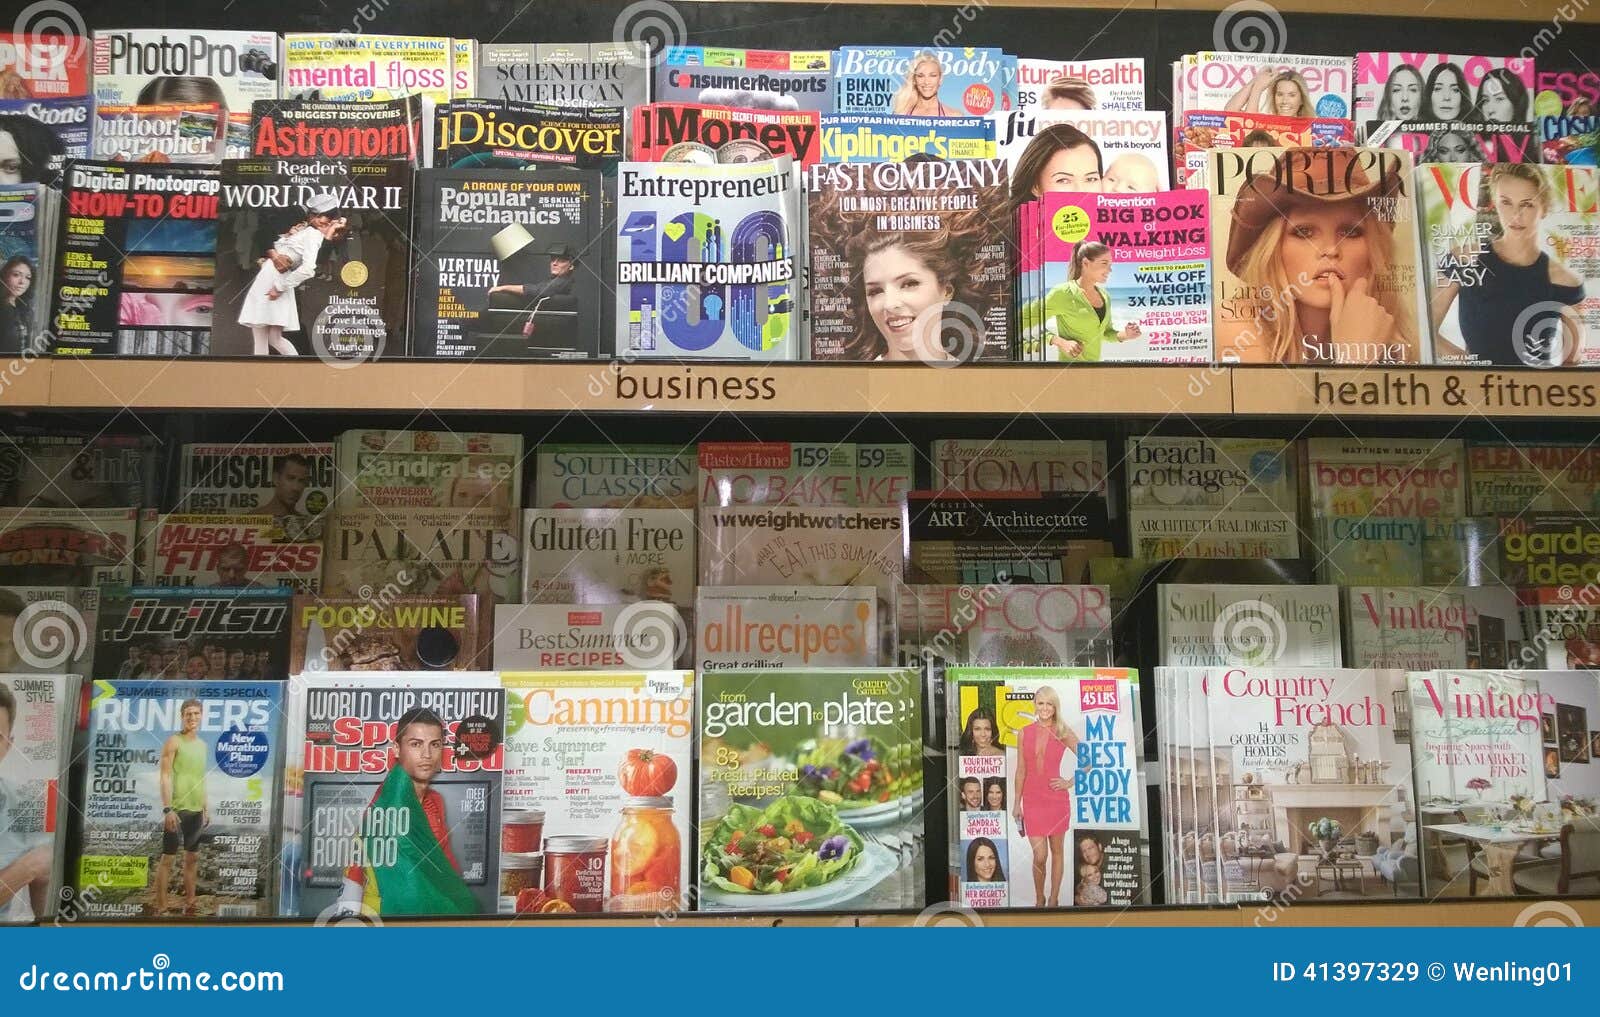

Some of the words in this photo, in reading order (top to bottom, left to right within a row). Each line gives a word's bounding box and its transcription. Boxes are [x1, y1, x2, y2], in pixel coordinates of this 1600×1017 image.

[289, 41, 315, 49] HOW
[359, 41, 371, 49] AT
[375, 40, 445, 49] EVERYTHING
[111, 33, 236, 76] PhotoPro
[289, 61, 445, 87] mental_floss
[497, 62, 625, 81] SCIENTIFIC
[500, 83, 624, 101] AMERICAN
[669, 70, 826, 96] ConsumerReports
[847, 94, 893, 107] READY
[295, 111, 338, 119] BIGGEST
[340, 110, 400, 119] DISCOVERIES
[451, 112, 620, 154] Discover
[656, 109, 816, 162] Money
[1000, 111, 1037, 146] fit
[1451, 123, 1483, 131] MUSIC
[1486, 124, 1531, 133] SPECIAL
[255, 117, 419, 160] Astronomy
[821, 127, 947, 162] Kiplinger's
[1131, 141, 1161, 149] beyond
[277, 161, 347, 176] Reader's
[811, 163, 871, 192] FAST
[873, 159, 1004, 192] COMPANY
[72, 173, 129, 191] Digital
[134, 174, 220, 195] Photograp
[291, 176, 319, 185] digest
[472, 183, 507, 191] DRONE
[623, 171, 790, 205] Entrepreneur
[70, 191, 164, 217] HOW-TO
[322, 186, 379, 208] WAR
[440, 188, 531, 209] Popular
[840, 198, 856, 211] 100
[861, 197, 887, 211] MOST
[891, 196, 938, 211] CREATIVE
[941, 195, 977, 210] PEOPLE
[1097, 196, 1156, 207] Prevention
[440, 206, 560, 224] Mechanics
[877, 216, 886, 230] IN
[891, 216, 940, 230] BUSINESS
[1063, 213, 1078, 222] 25
[1097, 208, 1134, 223] BIG
[1142, 205, 1204, 222] BOOK
[1098, 228, 1205, 247] WALKING
[1432, 223, 1493, 237] SUMMER
[1115, 249, 1132, 259] For
[1136, 248, 1176, 258] Weight
[1179, 247, 1205, 257] Loss
[1432, 236, 1490, 255] STYLE
[439, 258, 500, 273] VIRTUAL
[620, 263, 702, 282] BRILLIANT
[706, 260, 792, 284] COMPANIES
[440, 273, 500, 288] REALITY
[1134, 273, 1172, 284] WALK
[1178, 271, 1206, 282] OFF
[1435, 268, 1486, 288] EASY
[1149, 283, 1206, 295] WEIGHT
[329, 296, 376, 305] Illustrated
[1128, 296, 1145, 307] 3X
[1150, 294, 1206, 306] FASTER!
[326, 306, 379, 315] Celebration
[1140, 317, 1207, 326] METABOLISM
[1149, 331, 1170, 345] 23
[1172, 330, 1202, 338] Simple
[1172, 338, 1207, 346] Recipes
[329, 342, 373, 352] American
[1302, 335, 1411, 361] Summer
[616, 367, 776, 400] business
[1314, 372, 1429, 406] health
[1442, 376, 1467, 406] &
[1481, 374, 1596, 407] fitness
[796, 448, 829, 468] 159
[1135, 439, 1215, 464] beach
[360, 456, 456, 478] Sandra
[463, 458, 511, 478] Lee
[553, 453, 692, 477] SOUTHERN
[1131, 466, 1247, 493] cottages
[1316, 462, 1457, 493] backyard
[563, 476, 681, 500] CLASSICS
[736, 511, 900, 531] weightwatchers
[928, 511, 966, 527] ART
[984, 510, 1088, 528] Architecture
[1138, 519, 1243, 533] ARCHITECTURAL
[1245, 520, 1288, 533] DIGEST
[160, 525, 258, 544] MUSCLE
[530, 517, 616, 551] Gluten
[628, 517, 683, 551] Free
[336, 529, 518, 561] PALATE
[164, 544, 320, 575] FITESS
[302, 607, 374, 628] FOOD
[395, 607, 466, 628] WINE
[541, 652, 624, 667] RECIPES
[703, 660, 737, 671] Great
[14, 679, 54, 692] SUMMER
[1224, 669, 1335, 702] Country
[27, 691, 55, 703] STYLE
[310, 692, 371, 720] WORLD
[380, 691, 414, 720] CUP
[421, 691, 498, 721] PREVIEW
[720, 691, 746, 703] from
[1082, 692, 1096, 705] 45
[1098, 692, 1116, 705] LBS
[1424, 677, 1555, 733] Vintage
[525, 688, 691, 738] Canning
[705, 693, 812, 737] garden
[813, 711, 823, 721] to
[824, 692, 893, 735] plate
[1275, 696, 1387, 727] French
[1086, 715, 1116, 741] MY
[96, 733, 127, 748] RUN
[231, 733, 255, 743] New
[543, 737, 607, 753] Summer
[1231, 733, 1299, 745] GORGEOUS
[95, 749, 158, 764] STRONG,
[217, 743, 268, 753] Marathon
[230, 752, 253, 762] Plan
[1077, 742, 1126, 768] BEST
[1245, 746, 1286, 757] HOMES
[716, 747, 739, 770] 83
[94, 764, 130, 779] STAY
[93, 780, 136, 794] COOL!
[728, 782, 784, 799] Recipes!
[1075, 769, 1131, 795] BODY
[1077, 797, 1131, 823] EVER
[315, 807, 410, 836] CRISTIANO
[313, 837, 398, 867] RONALDO
[589, 857, 602, 870] 10
